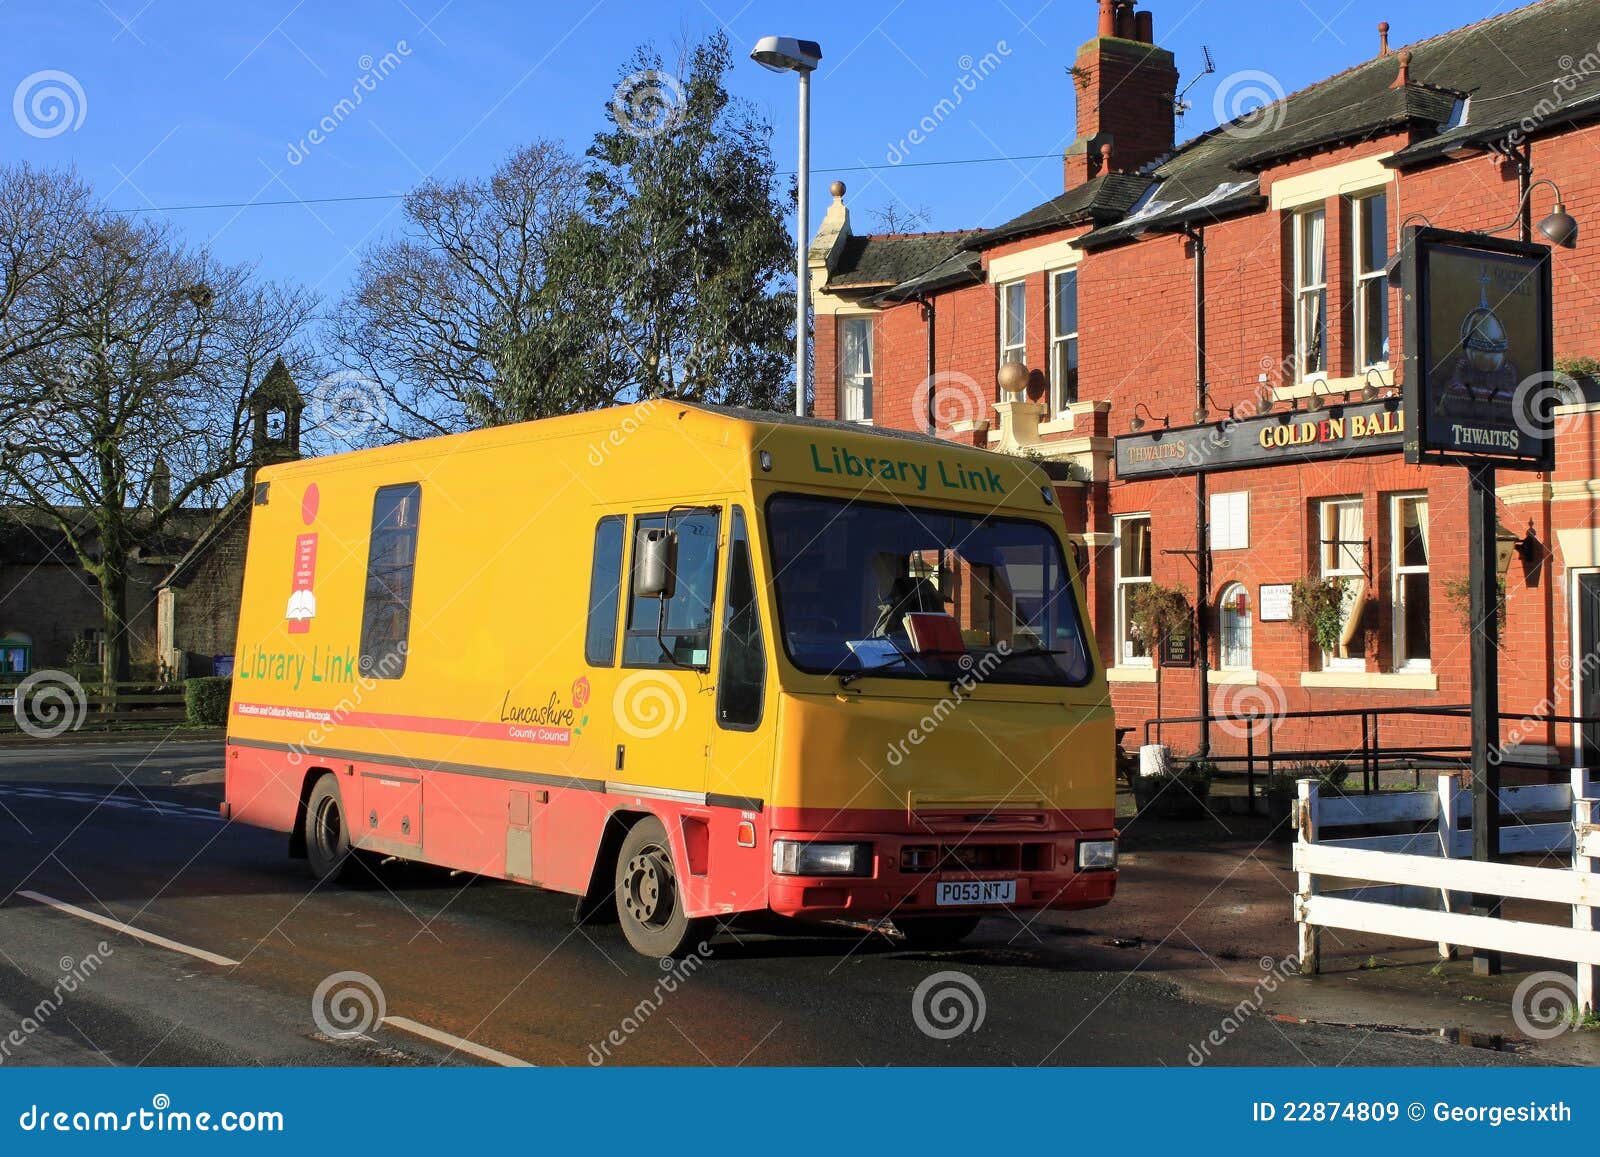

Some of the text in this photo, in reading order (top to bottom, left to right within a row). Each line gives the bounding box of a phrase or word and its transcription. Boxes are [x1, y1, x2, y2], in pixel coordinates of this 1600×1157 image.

[1128, 440, 1185, 464] THWAITES
[1259, 417, 1346, 448] GOLDEN
[1452, 424, 1519, 450] THWAITES
[810, 443, 1006, 495] Library Link
[240, 644, 355, 691] Library Link
[501, 690, 575, 727] Lancashire
[508, 726, 569, 743] County Council
[943, 882, 1010, 901] PO53 NTJ
